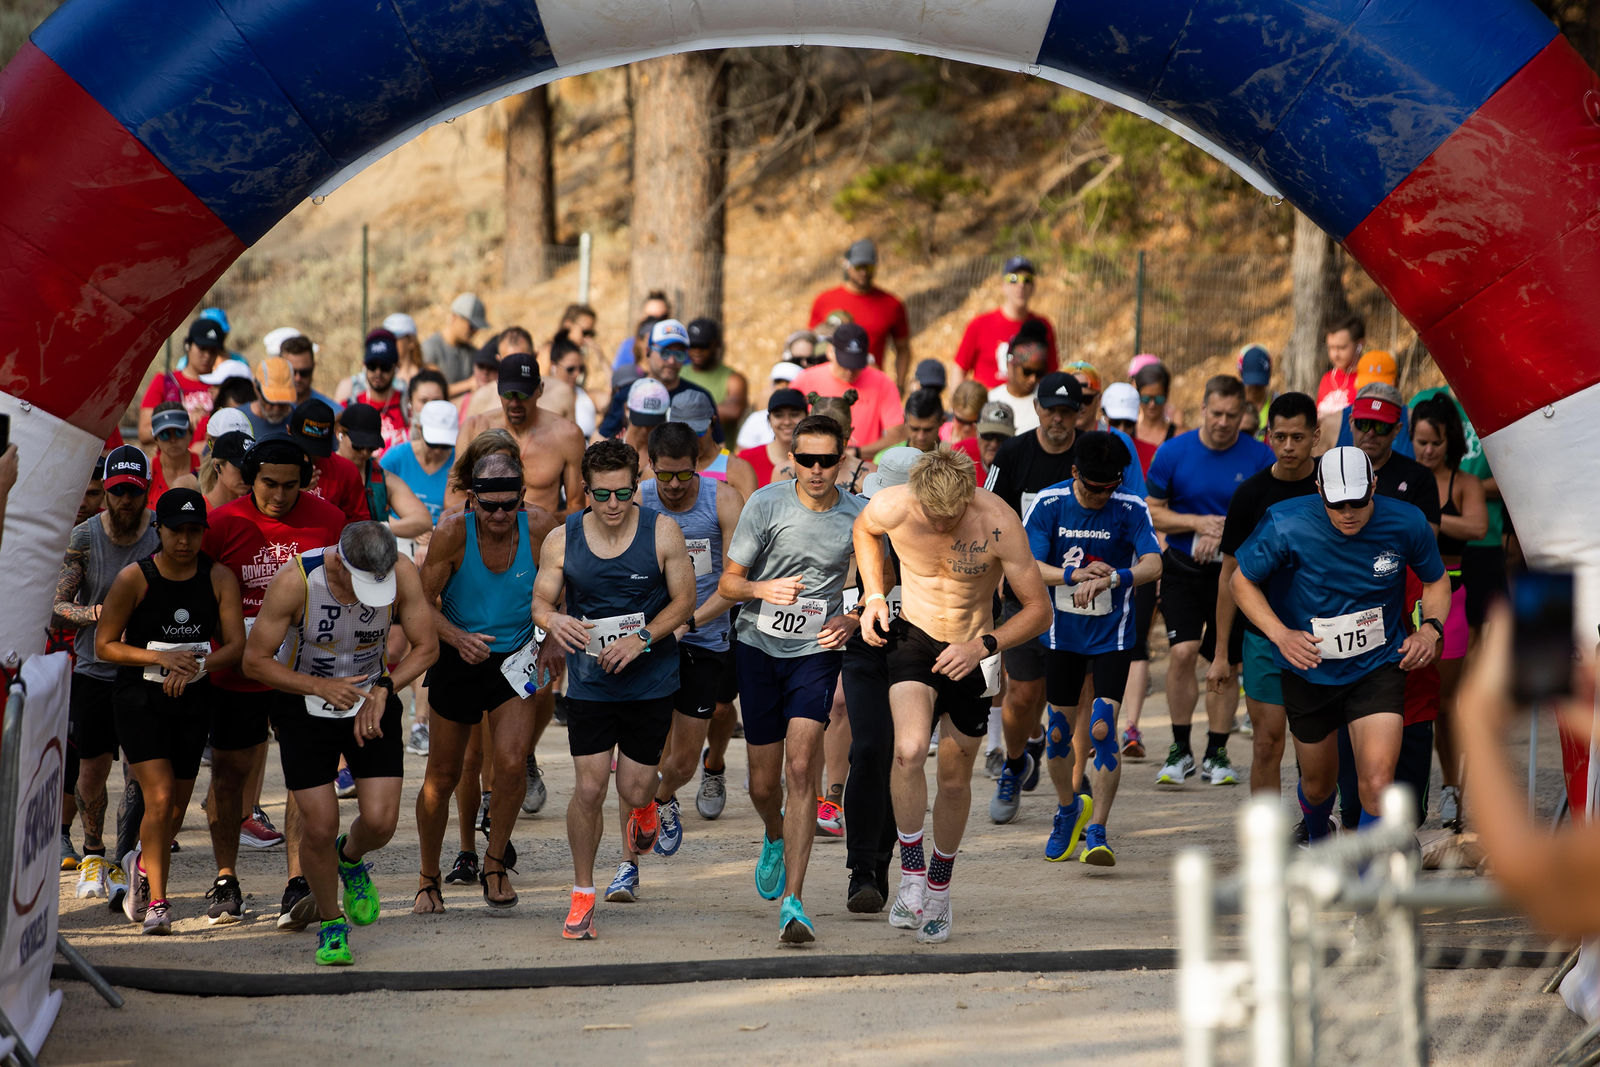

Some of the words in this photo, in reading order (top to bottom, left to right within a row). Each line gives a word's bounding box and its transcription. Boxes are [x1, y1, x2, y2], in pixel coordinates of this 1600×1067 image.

[117, 461, 141, 471] BASE
[1058, 526, 1111, 540] Panasonic
[951, 539, 967, 552] In
[969, 540, 988, 553] God
[241, 563, 277, 581] BOWERS
[947, 558, 990, 575] Trust
[771, 610, 807, 634] 202
[161, 624, 201, 635] VorteX
[354, 628, 385, 639] MUSCLE
[1334, 628, 1368, 653] 175
